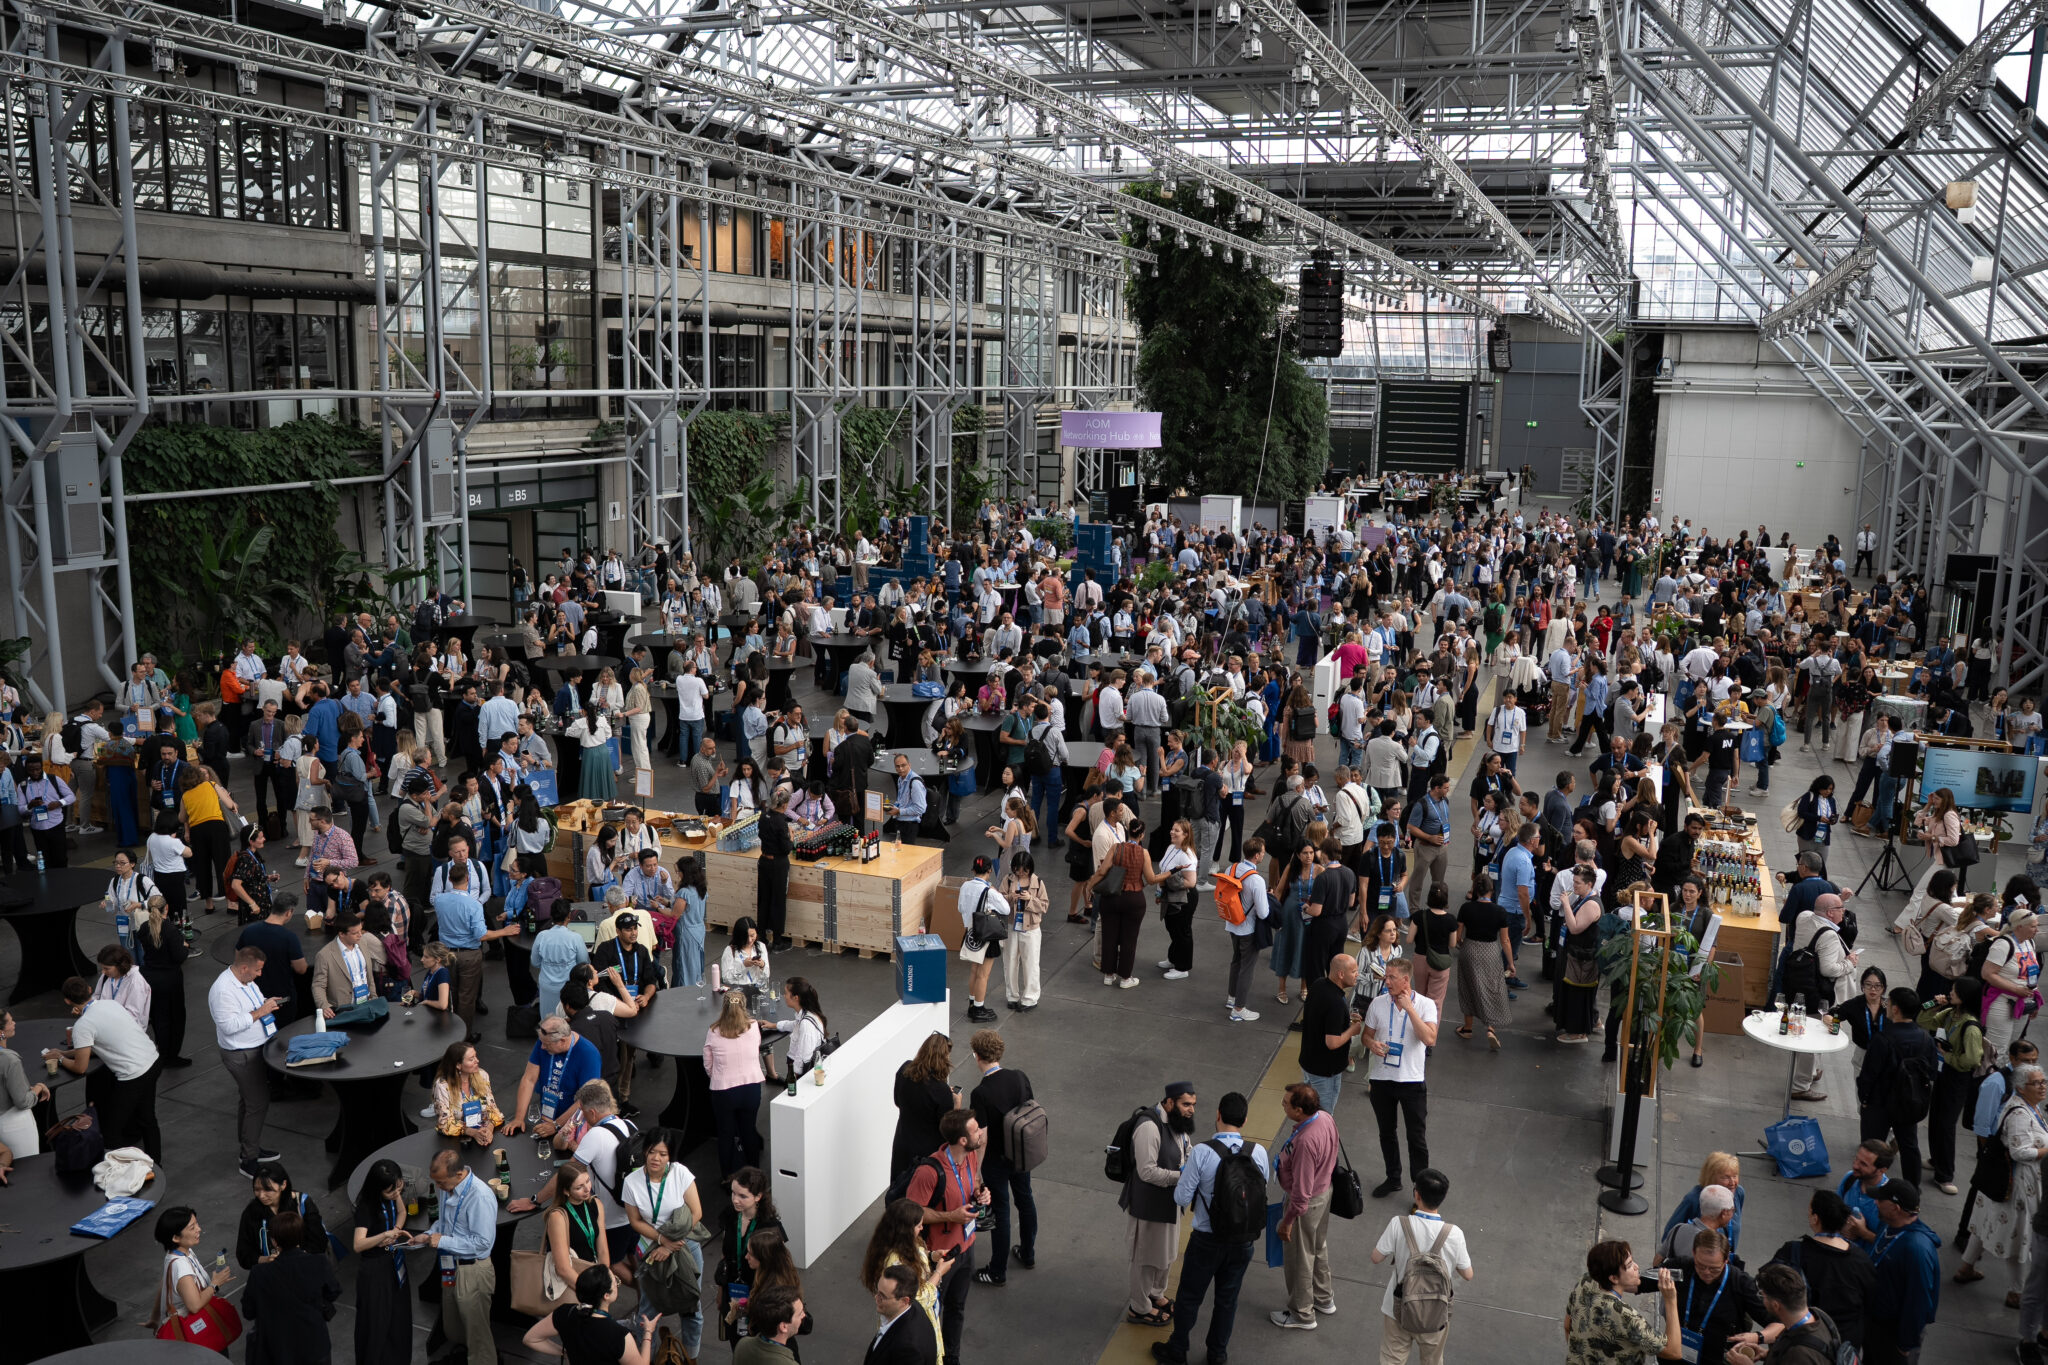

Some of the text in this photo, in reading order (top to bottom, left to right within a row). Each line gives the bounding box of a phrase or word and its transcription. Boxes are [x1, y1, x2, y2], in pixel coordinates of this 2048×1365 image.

[1085, 418, 1110, 429] AOM
[1063, 430, 1107, 443] Networking
[1109, 431, 1131, 441] Hub
[469, 494, 481, 506] B4
[515, 490, 527, 501] B5
